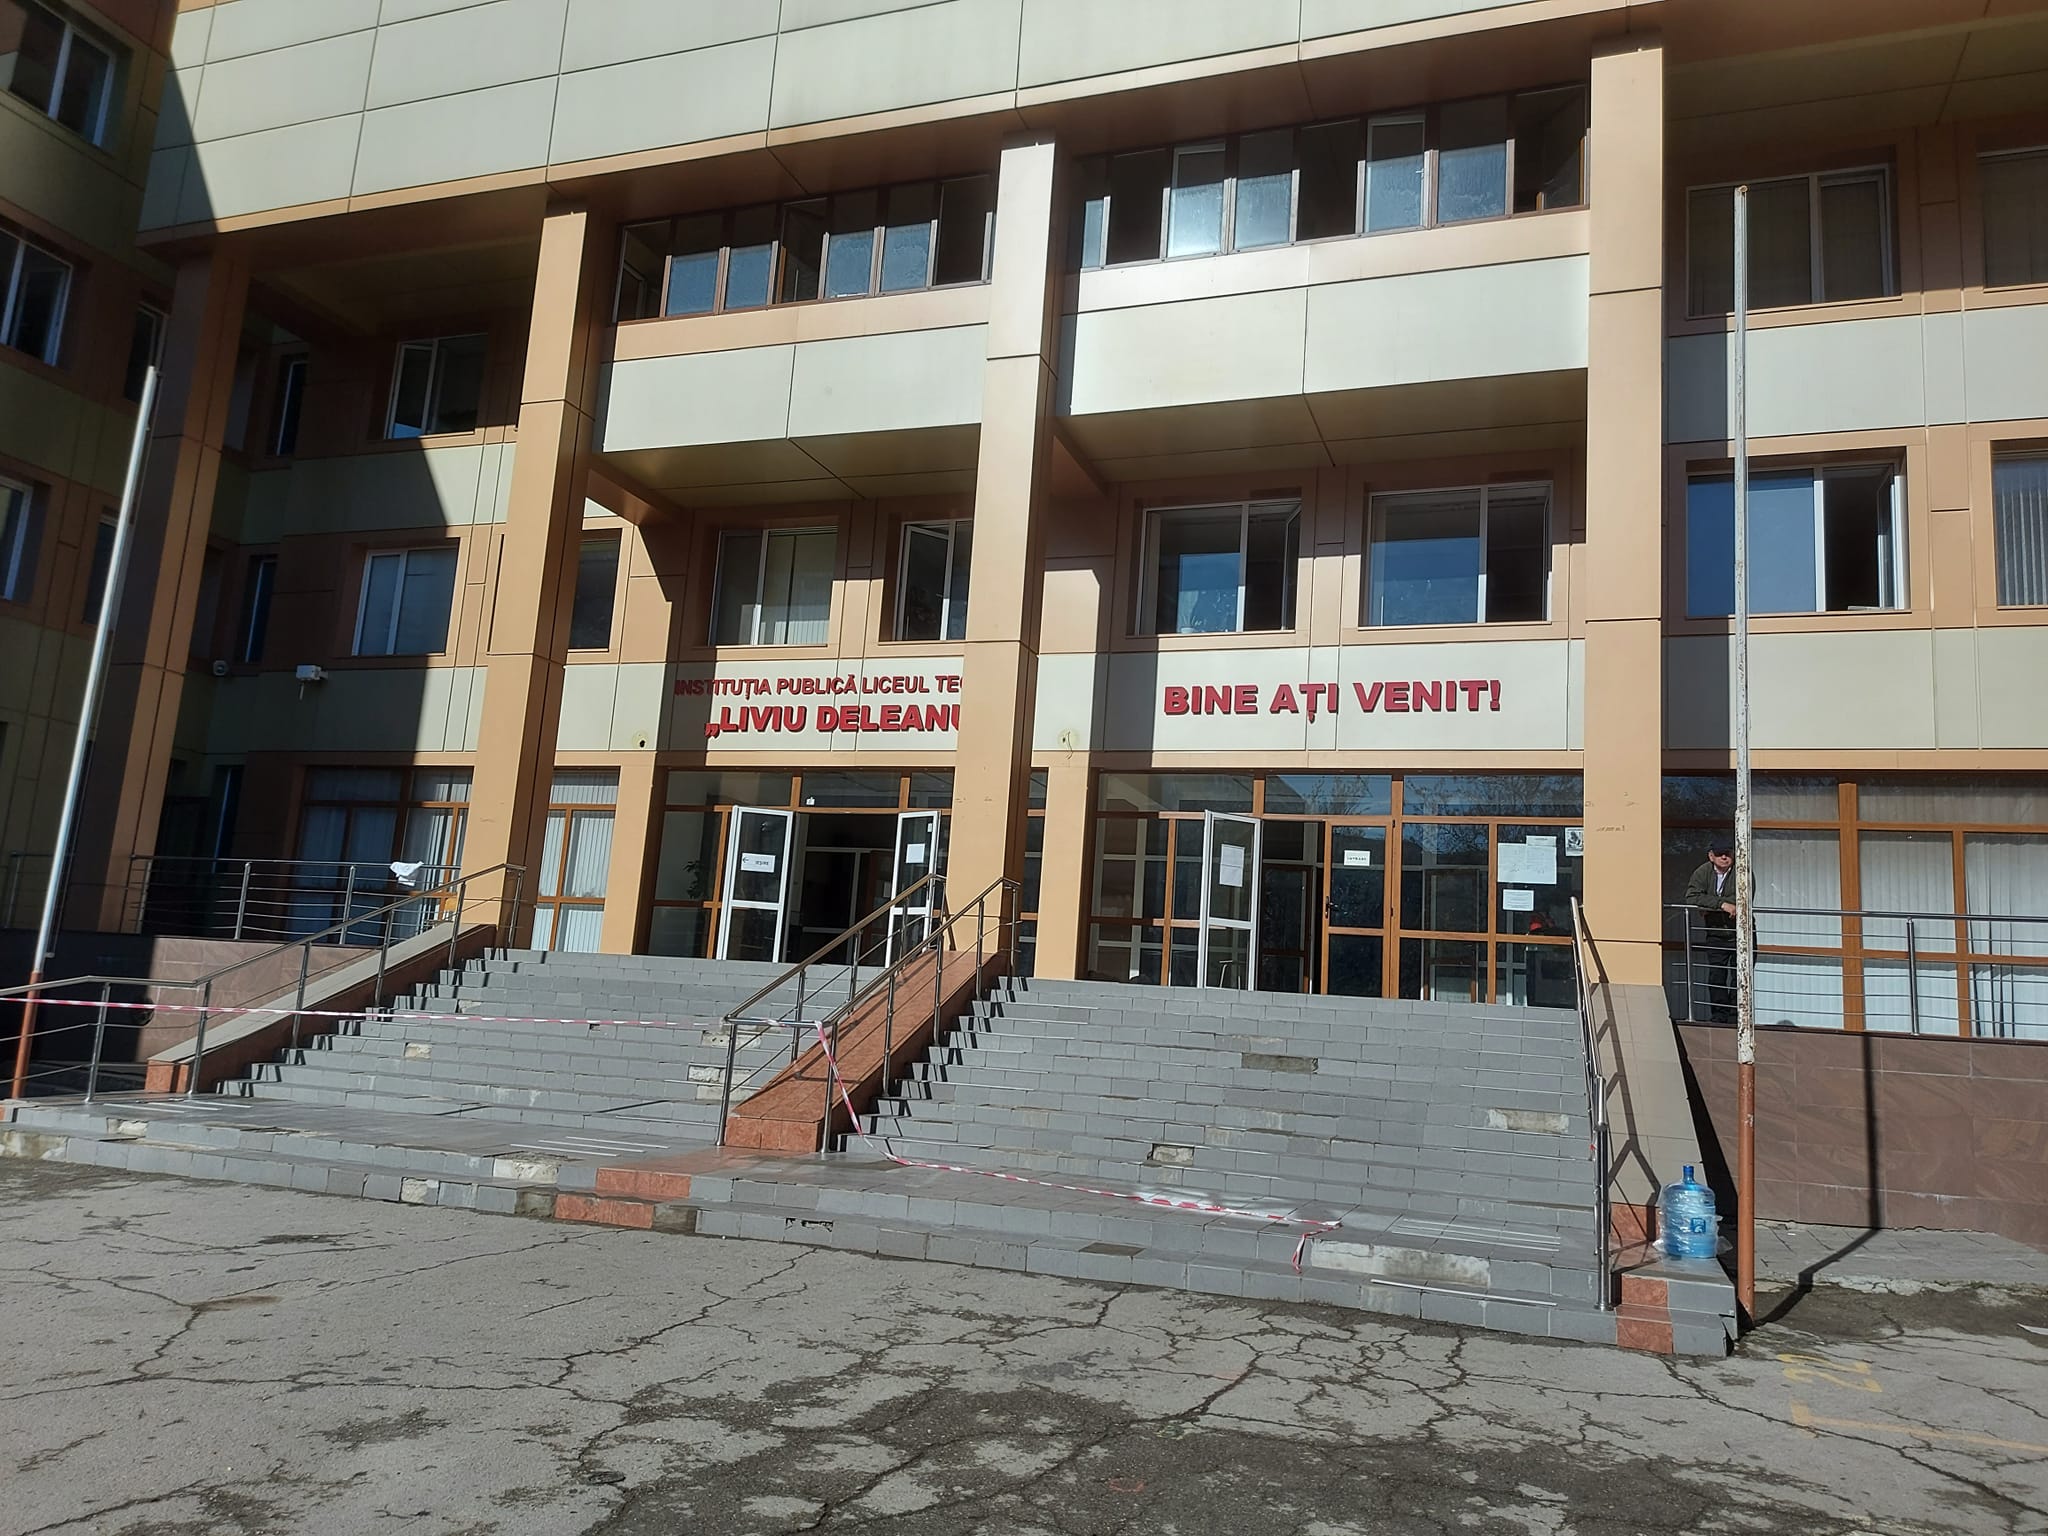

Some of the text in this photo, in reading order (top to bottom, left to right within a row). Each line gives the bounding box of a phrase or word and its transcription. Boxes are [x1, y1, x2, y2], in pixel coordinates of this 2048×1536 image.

[674, 674, 963, 701] INSTITUȚIA PUBLICĂ LICEUL TE
[1163, 679, 1501, 724] BINE AȚI VENIT!
